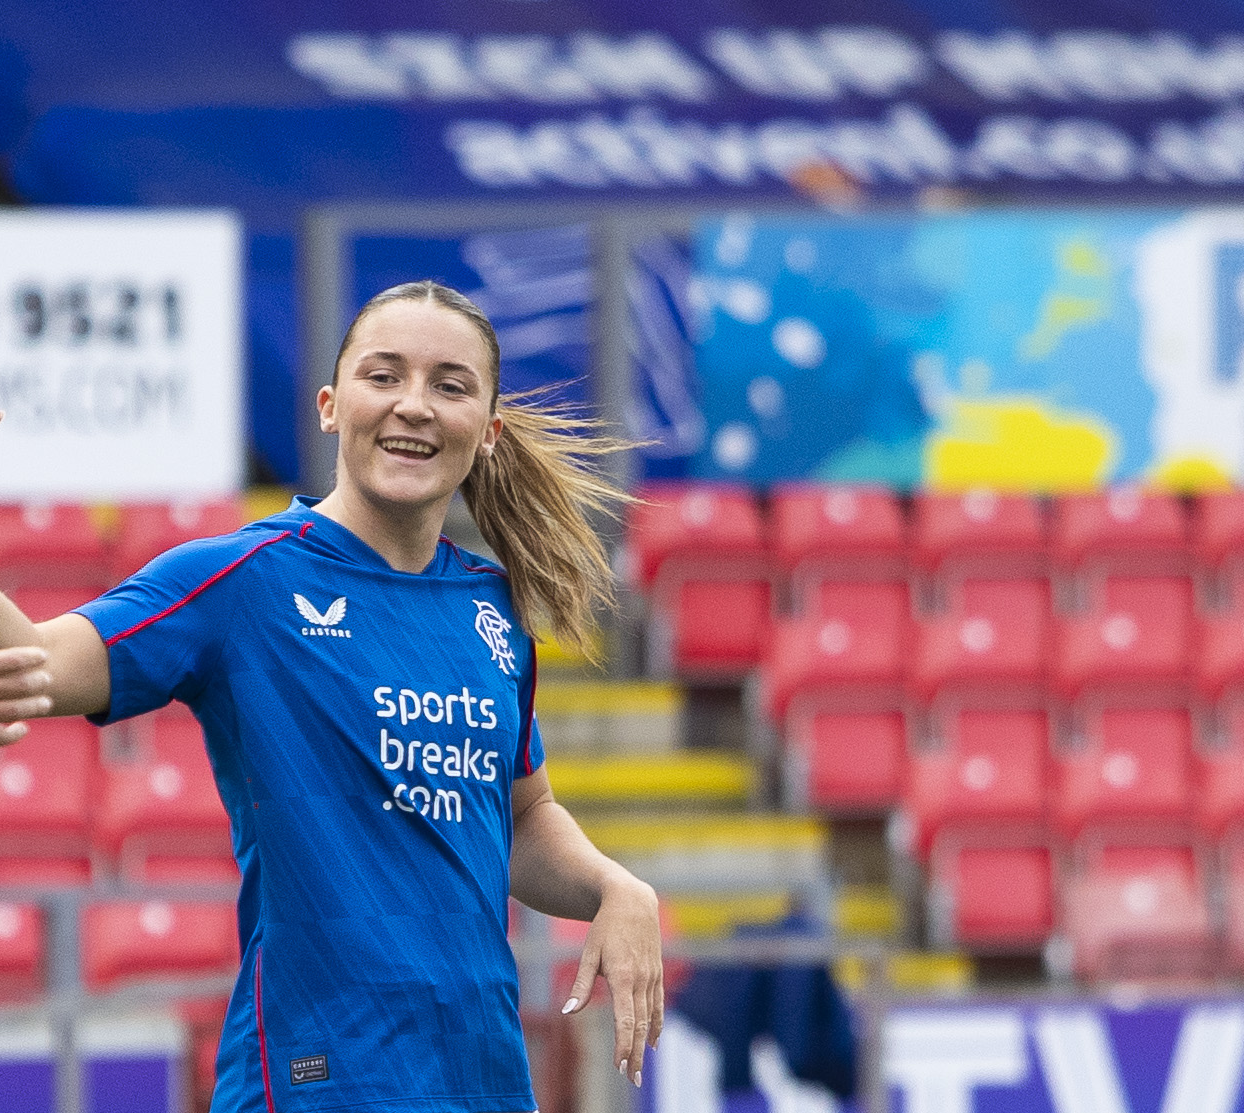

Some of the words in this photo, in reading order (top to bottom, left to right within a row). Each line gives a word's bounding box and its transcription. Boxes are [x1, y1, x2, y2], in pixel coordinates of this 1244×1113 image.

[9, 279, 184, 346] 9521
[301, 627, 352, 638] CASTORE
[373, 686, 498, 730] sports
[380, 728, 499, 782] breaks
[382, 783, 462, 823] .com
